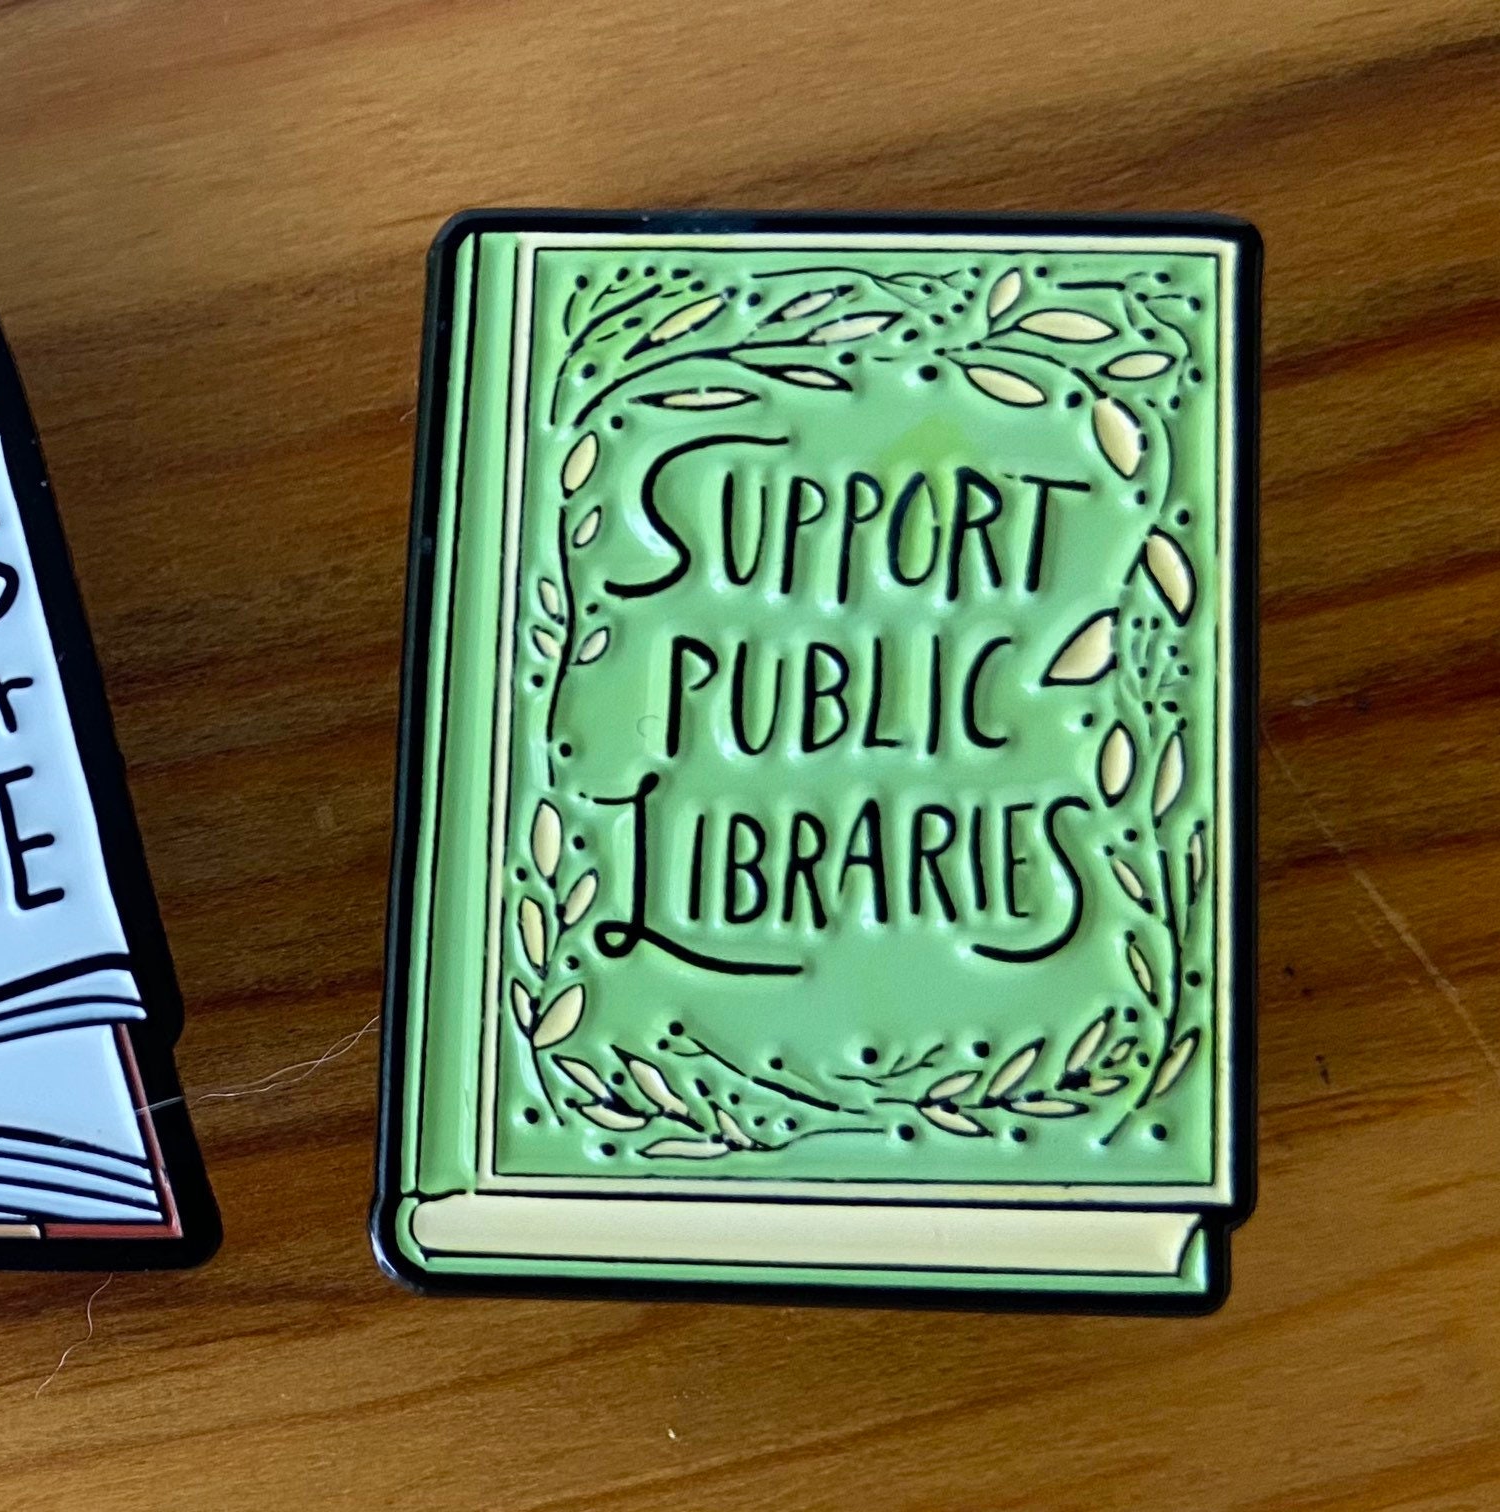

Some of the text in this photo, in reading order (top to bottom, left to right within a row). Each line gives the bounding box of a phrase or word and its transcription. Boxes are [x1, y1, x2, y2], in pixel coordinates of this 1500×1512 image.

[603, 433, 1092, 605] SUPPORT
[665, 634, 1013, 758] PUBLIC
[584, 772, 1092, 976] LIBRARIES
